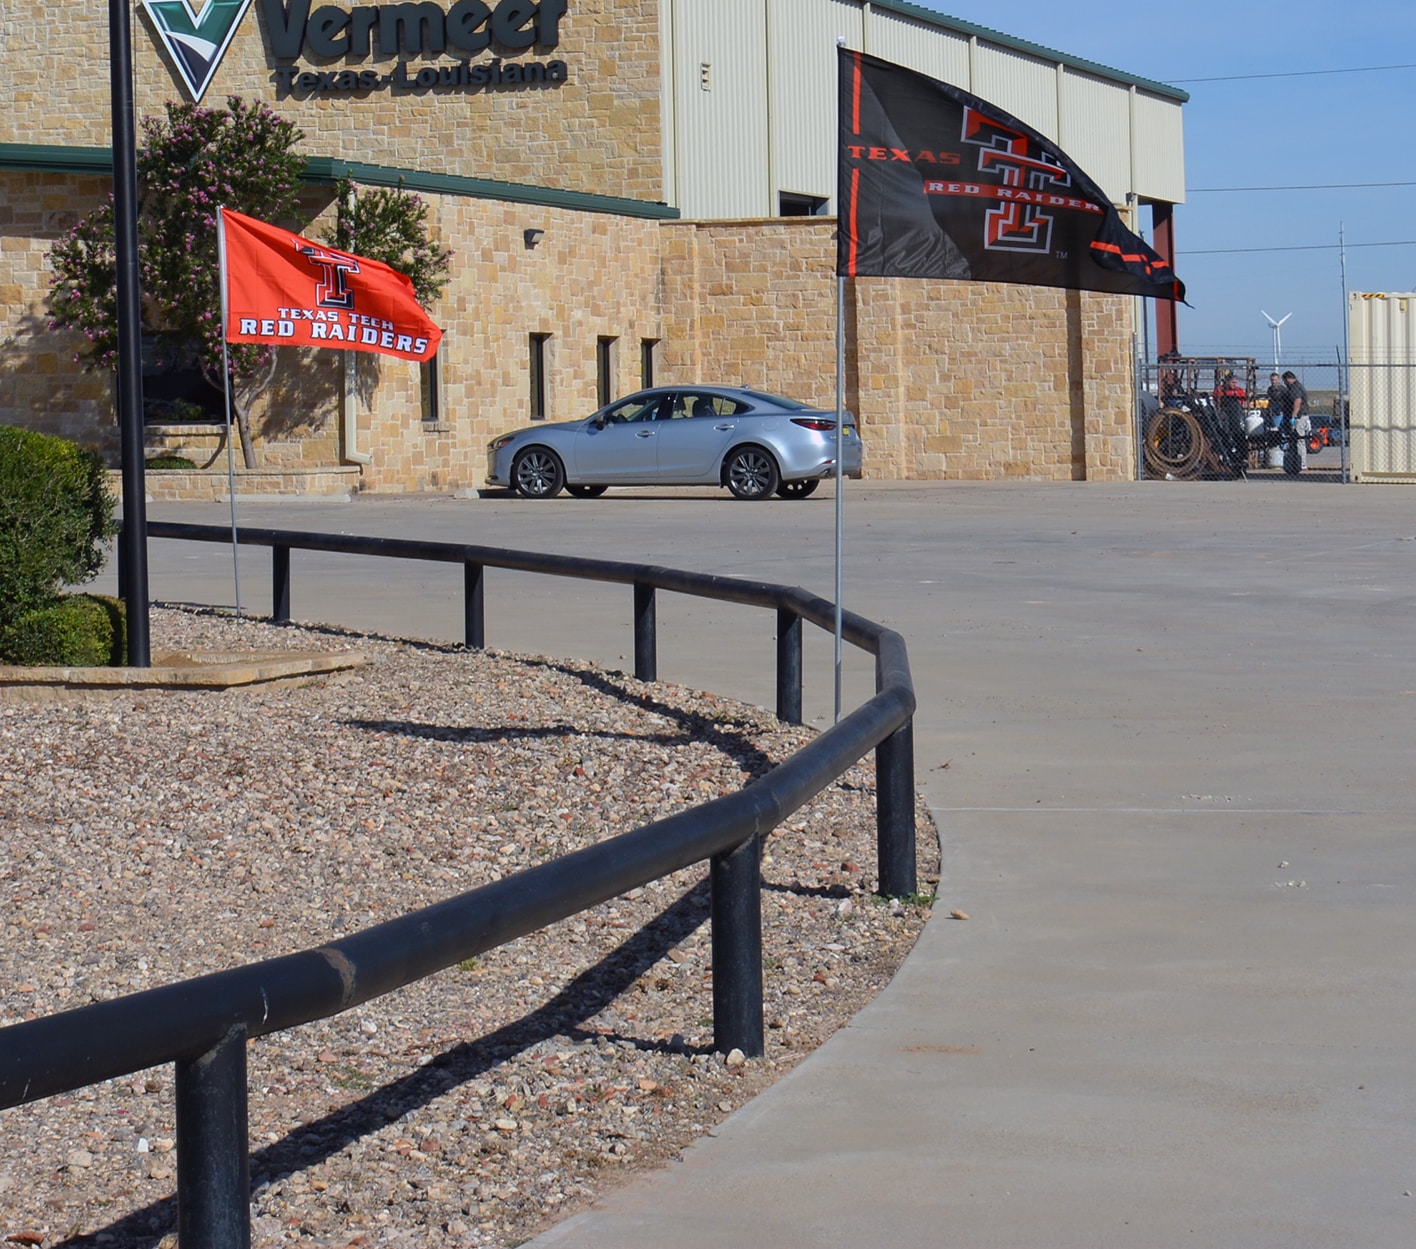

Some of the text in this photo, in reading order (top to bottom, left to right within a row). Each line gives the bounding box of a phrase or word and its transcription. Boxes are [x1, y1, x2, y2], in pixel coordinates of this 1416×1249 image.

[847, 145, 961, 165] TEXAS
[929, 181, 980, 194] RED
[277, 307, 395, 331] TEXAS TECH
[239, 318, 430, 355] RED RAIDERS
